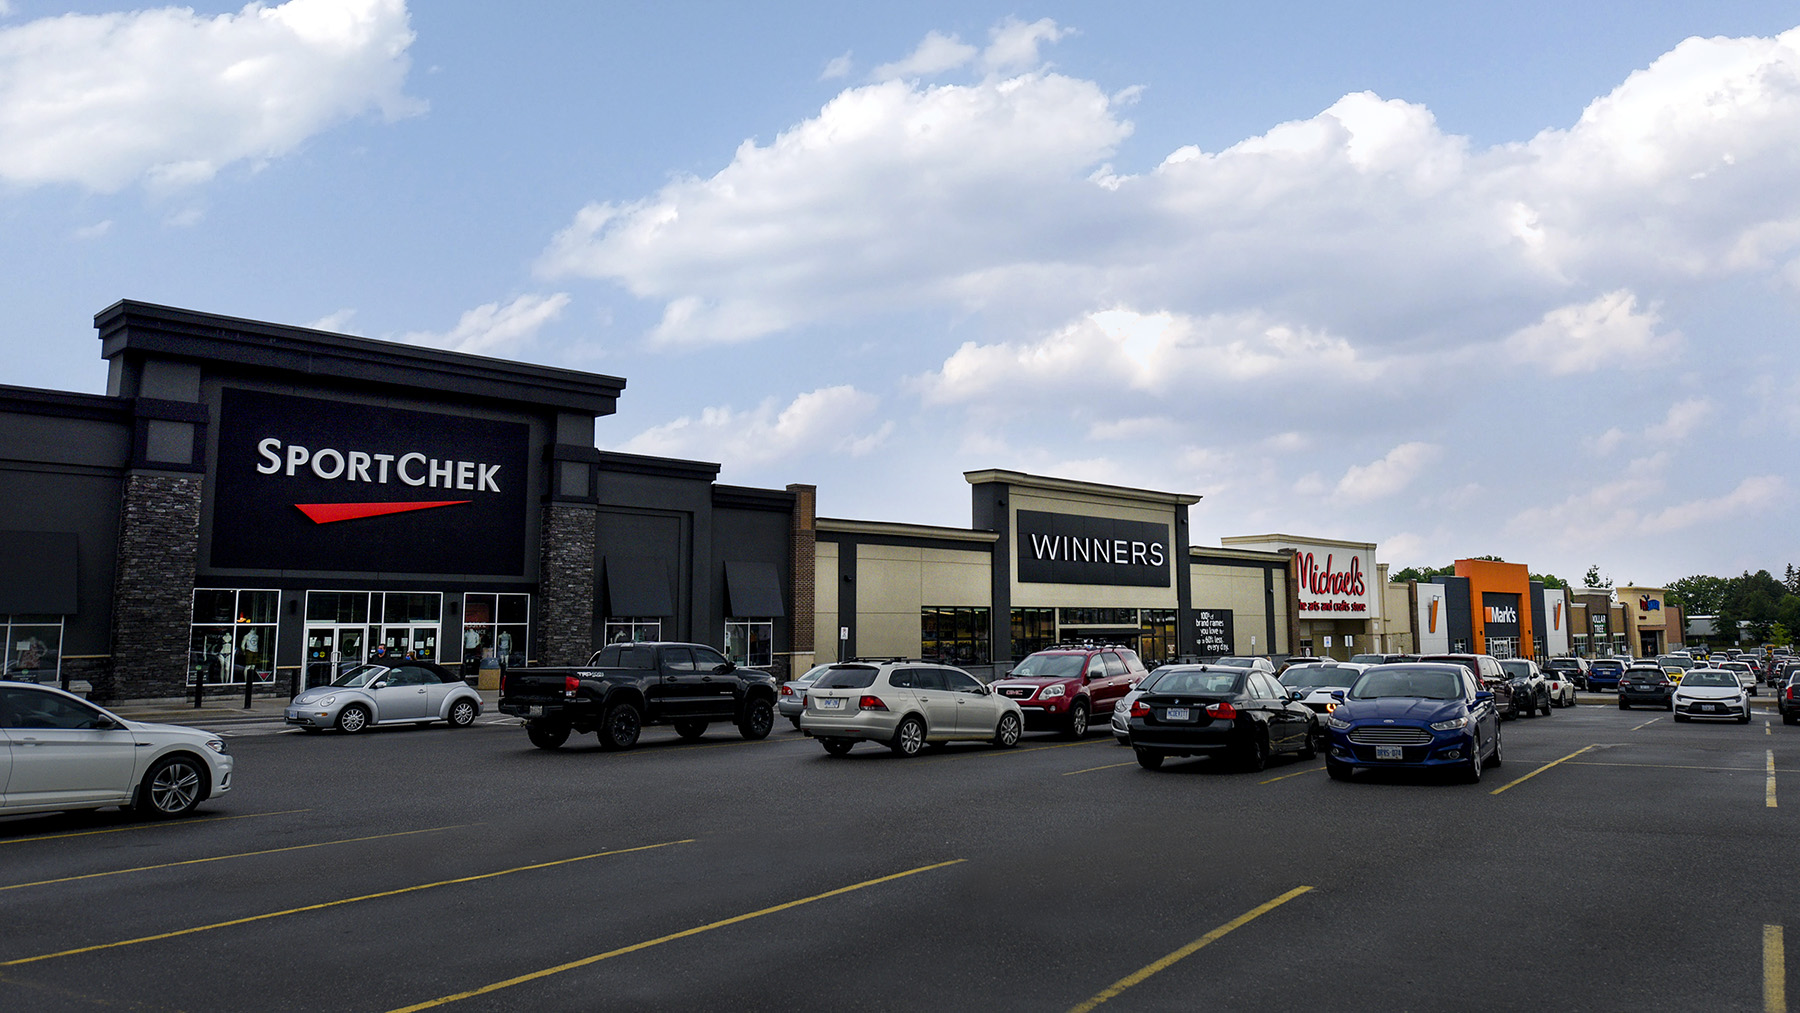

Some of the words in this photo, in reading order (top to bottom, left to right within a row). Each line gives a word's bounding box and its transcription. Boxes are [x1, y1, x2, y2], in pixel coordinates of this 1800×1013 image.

[1031, 533, 1164, 567] WINNERS
[1297, 551, 1366, 596] Michaels
[1298, 599, 1307, 611] he
[1308, 601, 1320, 612] arts
[1321, 600, 1333, 611] and
[1334, 600, 1350, 612] crafts
[1351, 602, 1366, 612] store
[1491, 605, 1517, 624] Mark's
[1195, 619, 1209, 627] brand
[1200, 628, 1208, 637] you
[1209, 627, 1218, 635] love
